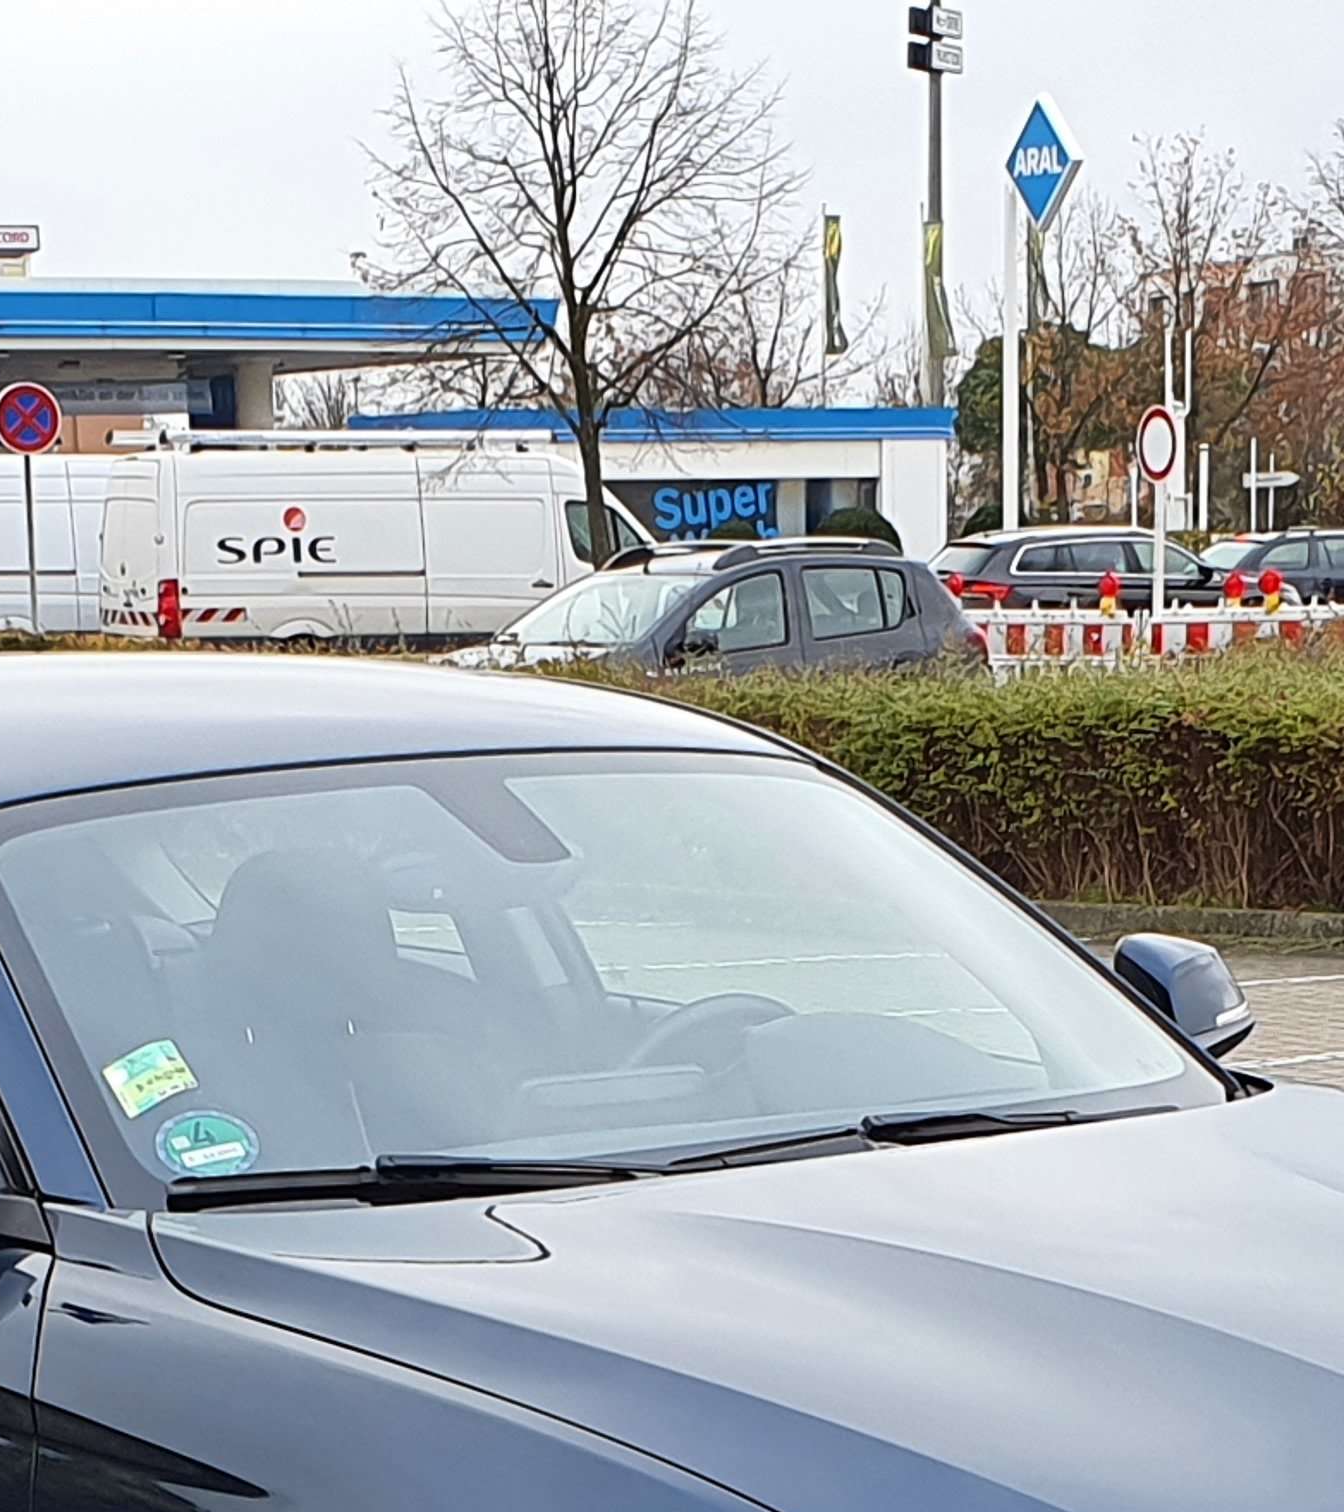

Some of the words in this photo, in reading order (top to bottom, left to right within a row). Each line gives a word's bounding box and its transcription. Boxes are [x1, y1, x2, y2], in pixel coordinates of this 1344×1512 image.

[1013, 144, 1064, 178] ARAL
[654, 483, 772, 530] Super
[217, 536, 337, 564] SPIE
